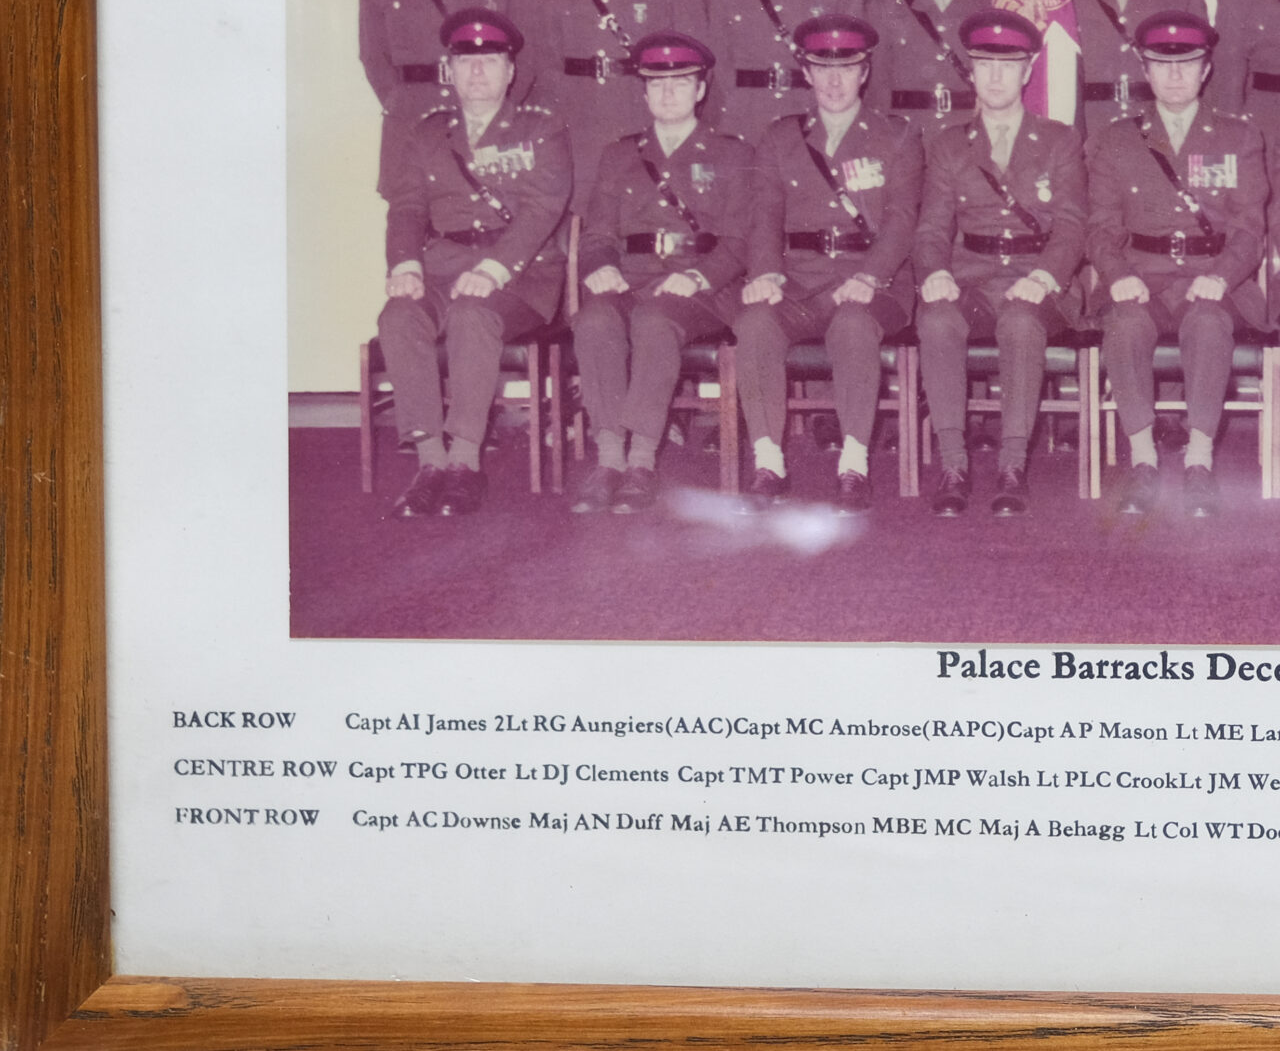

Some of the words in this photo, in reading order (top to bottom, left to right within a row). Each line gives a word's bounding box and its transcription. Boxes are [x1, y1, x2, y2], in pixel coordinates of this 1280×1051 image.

[936, 648, 1041, 680] Palace
[1050, 649, 1195, 681] Barracks
[172, 710, 236, 729] BACK
[241, 711, 297, 729] ROW
[345, 712, 392, 735] Capt
[395, 712, 420, 731] AI
[424, 713, 487, 736] James
[494, 714, 529, 733] 2Lt
[532, 714, 567, 733] RG
[785, 717, 824, 736] MC
[1098, 721, 1169, 741] Mason
[1175, 722, 1199, 741] Lt
[1203, 722, 1245, 741] ME
[173, 758, 275, 778] CENTRE
[282, 760, 338, 778] ROW
[348, 761, 396, 784] Capt
[400, 761, 449, 780] TPG
[454, 762, 507, 781] Otter
[514, 763, 538, 781] Lt
[542, 763, 570, 786] DJ
[575, 763, 670, 783] Clements
[677, 765, 725, 788] Capt
[728, 766, 786, 785] TMT
[789, 766, 855, 785] Power
[861, 767, 910, 791] Capt
[911, 768, 962, 791] JMP
[965, 769, 1031, 788] Walsh
[1036, 770, 1060, 789] Lt
[1064, 770, 1112, 788] PLC
[1206, 772, 1242, 795] JM
[175, 807, 260, 826] FRONT
[264, 808, 320, 826] ROW
[352, 809, 399, 832] Capt
[405, 810, 438, 829] AC
[441, 811, 522, 830] Downse
[528, 811, 569, 834] Maj
[573, 812, 611, 832] AN
[615, 812, 664, 831] Duff
[670, 813, 710, 836] Maj
[717, 814, 751, 833] AE
[755, 815, 866, 838] Thompson
[871, 816, 928, 835] MBE
[934, 818, 972, 837] MC
[978, 818, 1020, 842] Maj
[1023, 818, 1042, 837] A
[1047, 819, 1126, 843] Behagg
[1133, 820, 1158, 840] Lt
[1162, 821, 1199, 840] Col
[1204, 821, 1244, 840] WT
